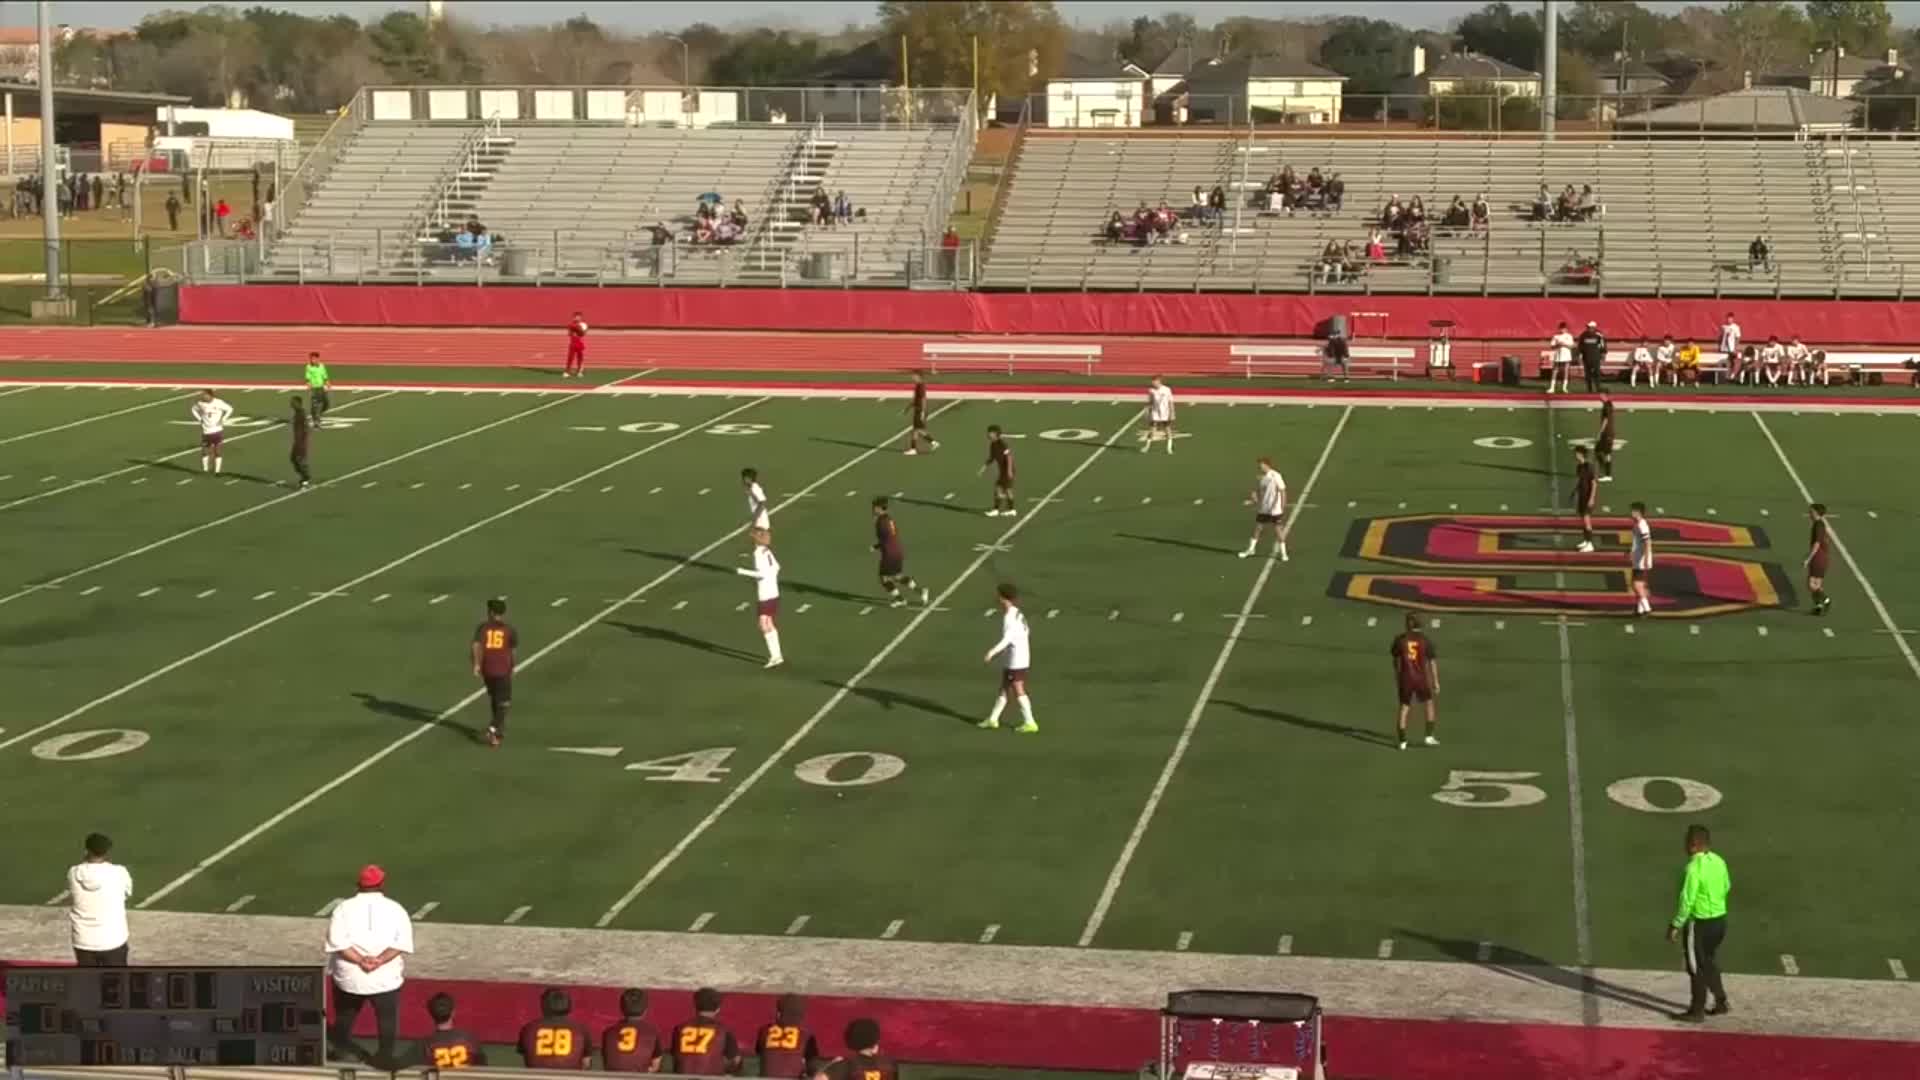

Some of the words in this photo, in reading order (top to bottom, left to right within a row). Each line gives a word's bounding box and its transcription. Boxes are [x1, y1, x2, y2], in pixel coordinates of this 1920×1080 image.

[485, 629, 505, 649] 16
[1407, 640, 1419, 660] 5
[535, 1028, 573, 1056] 28
[617, 1027, 638, 1051] 3
[680, 1027, 716, 1054] 27
[766, 1025, 800, 1050] 23
